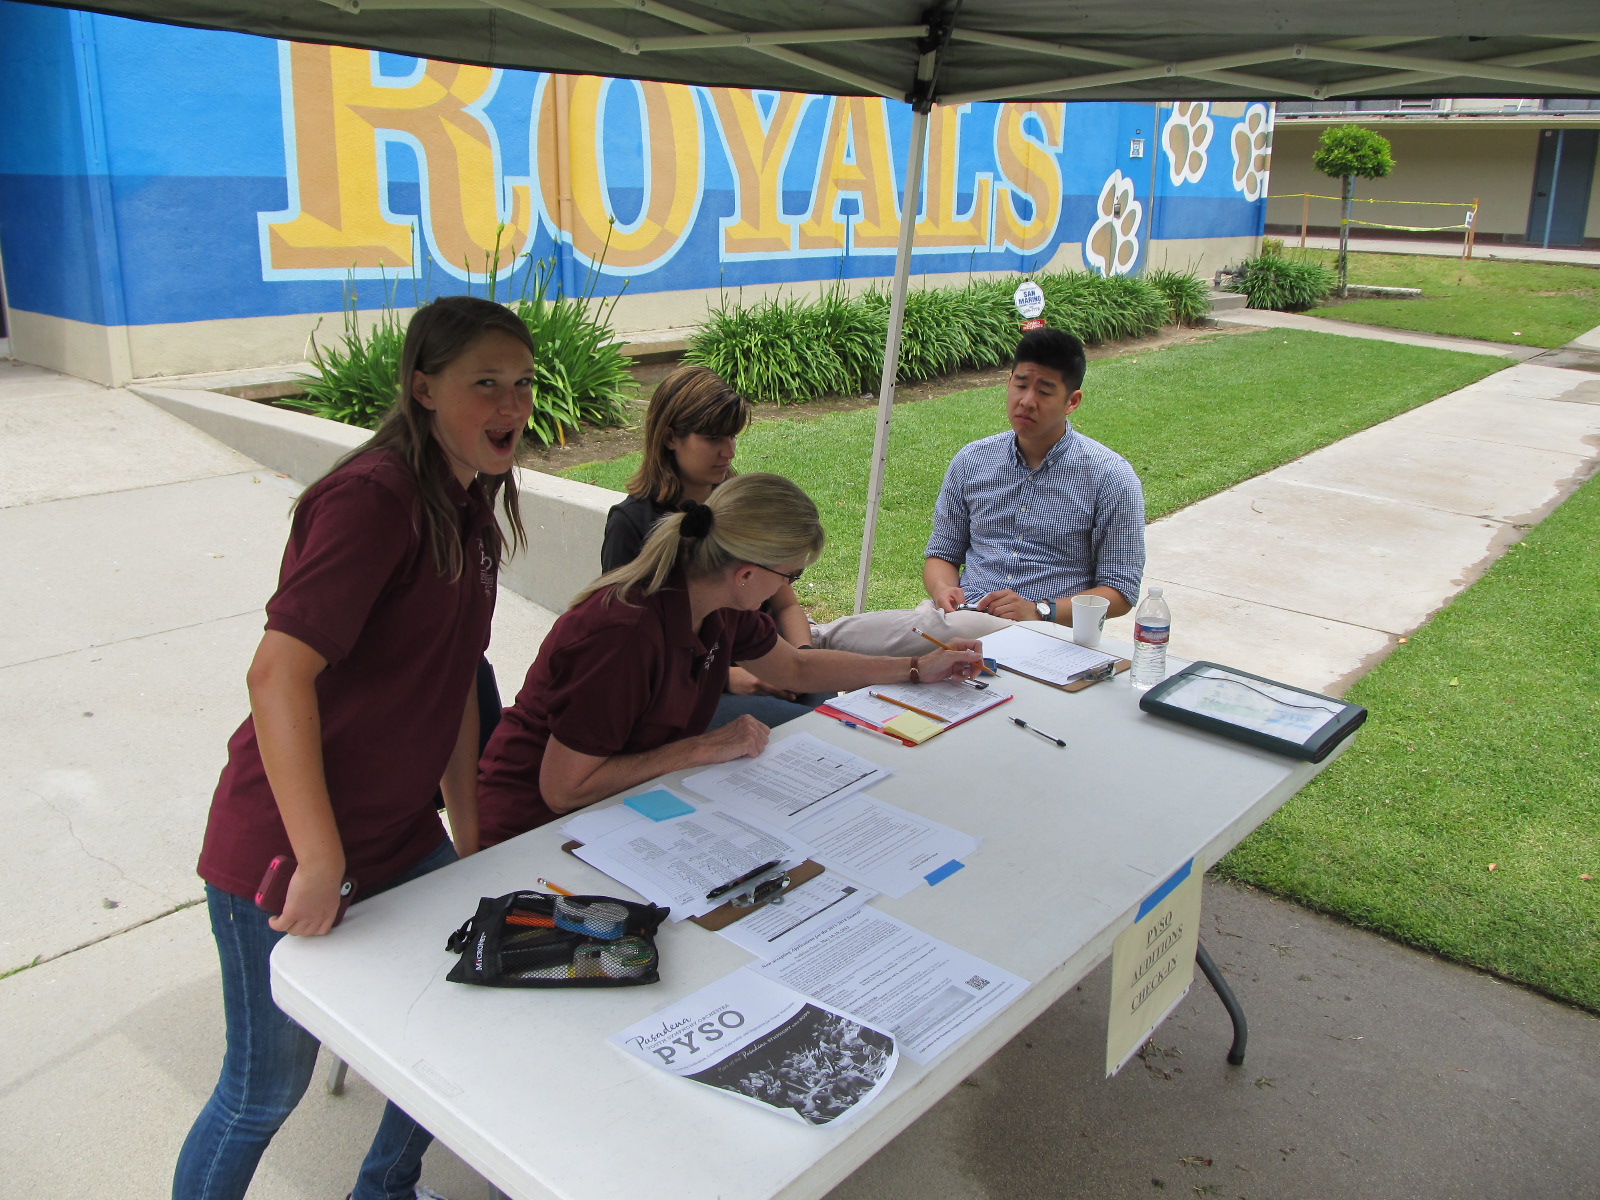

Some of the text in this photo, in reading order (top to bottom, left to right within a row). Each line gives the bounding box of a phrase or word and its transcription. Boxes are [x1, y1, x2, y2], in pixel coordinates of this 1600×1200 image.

[257, 43, 1065, 283] ROYALS
[1018, 295, 1042, 305] MARINO
[1023, 289, 1036, 298] SAN
[1145, 911, 1173, 947] PYSO
[1131, 923, 1184, 985] AUDITIONS
[1131, 953, 1179, 1011] CHECK-IN
[625, 1017, 692, 1051] Pasadena
[646, 1004, 730, 1050] YOUTH SYMPHONY ORCHESTRA
[652, 1010, 745, 1065] PYSO
